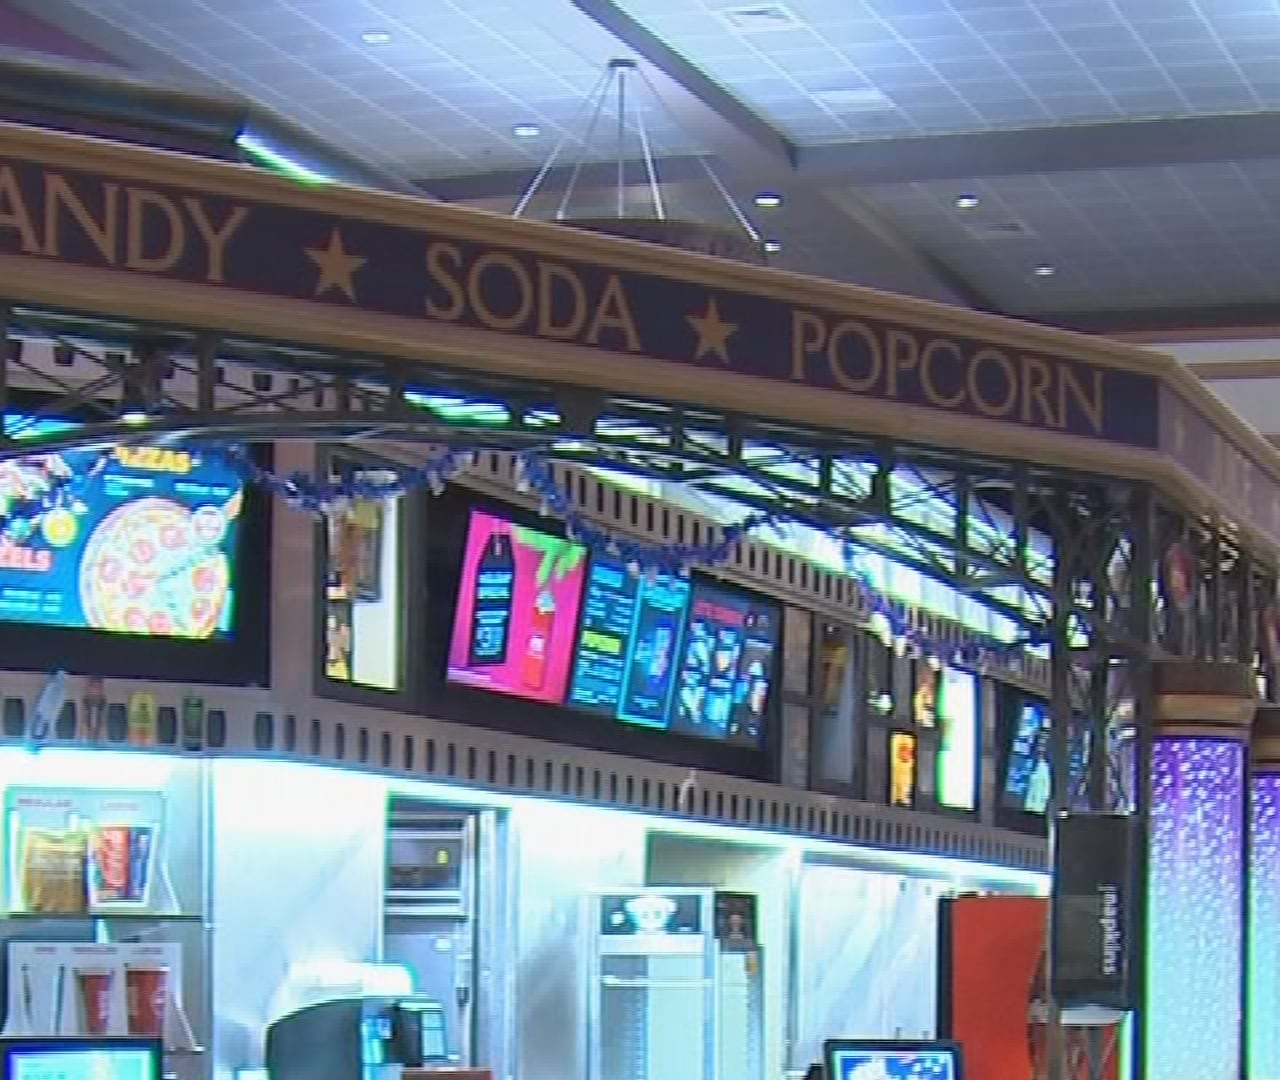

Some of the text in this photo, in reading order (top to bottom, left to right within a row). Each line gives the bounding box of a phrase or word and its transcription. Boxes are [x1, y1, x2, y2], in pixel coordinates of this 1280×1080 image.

[425, 240, 642, 352] SODA
[789, 308, 1106, 434] POPCORN
[1097, 884, 1122, 976] napkins
